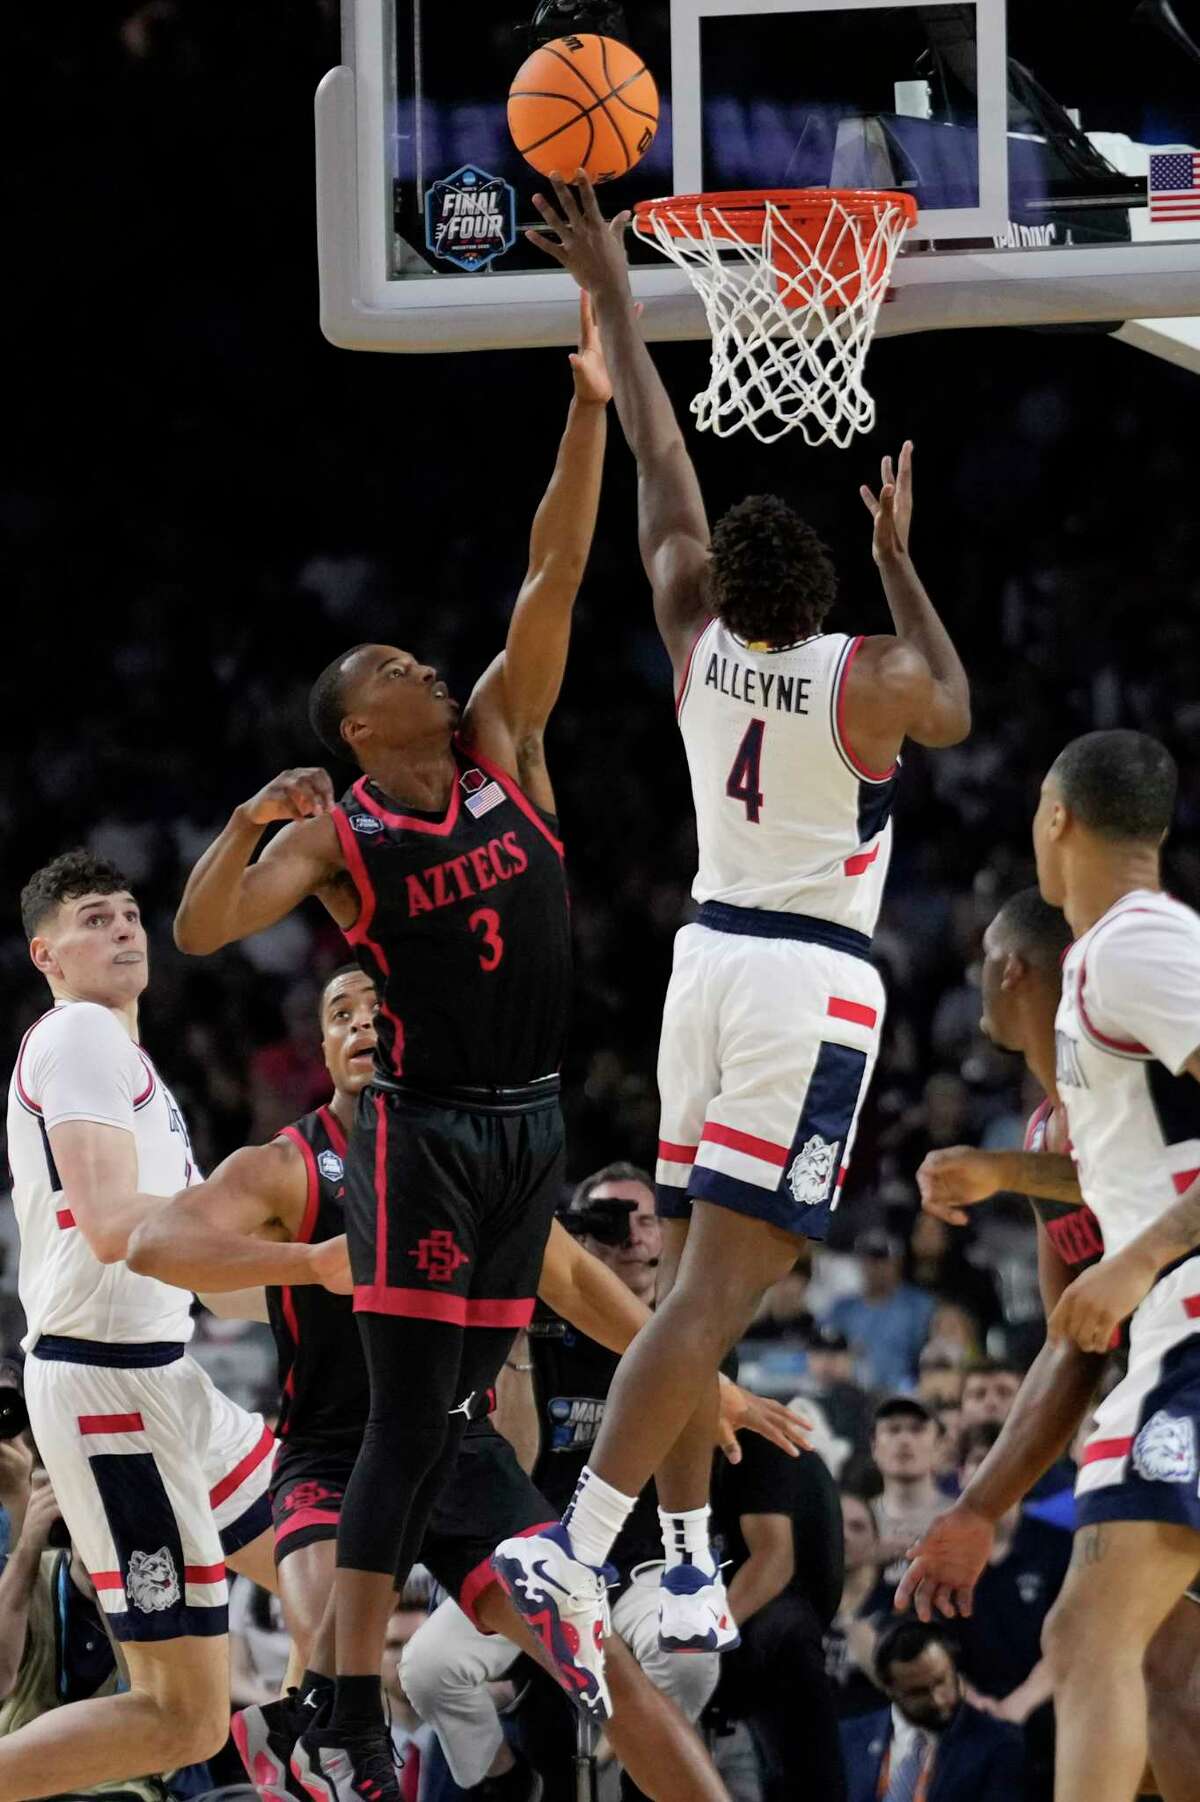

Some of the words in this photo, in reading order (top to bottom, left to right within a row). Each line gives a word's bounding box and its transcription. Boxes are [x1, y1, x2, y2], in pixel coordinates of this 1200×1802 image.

[442, 191, 499, 217] FINAL
[447, 214, 503, 240] FOUR
[704, 652, 812, 715] ALLEYNE
[725, 717, 767, 825] 4
[404, 831, 529, 918] AZTECS
[467, 906, 505, 972] 3
[570, 1401, 608, 1423] MAR
